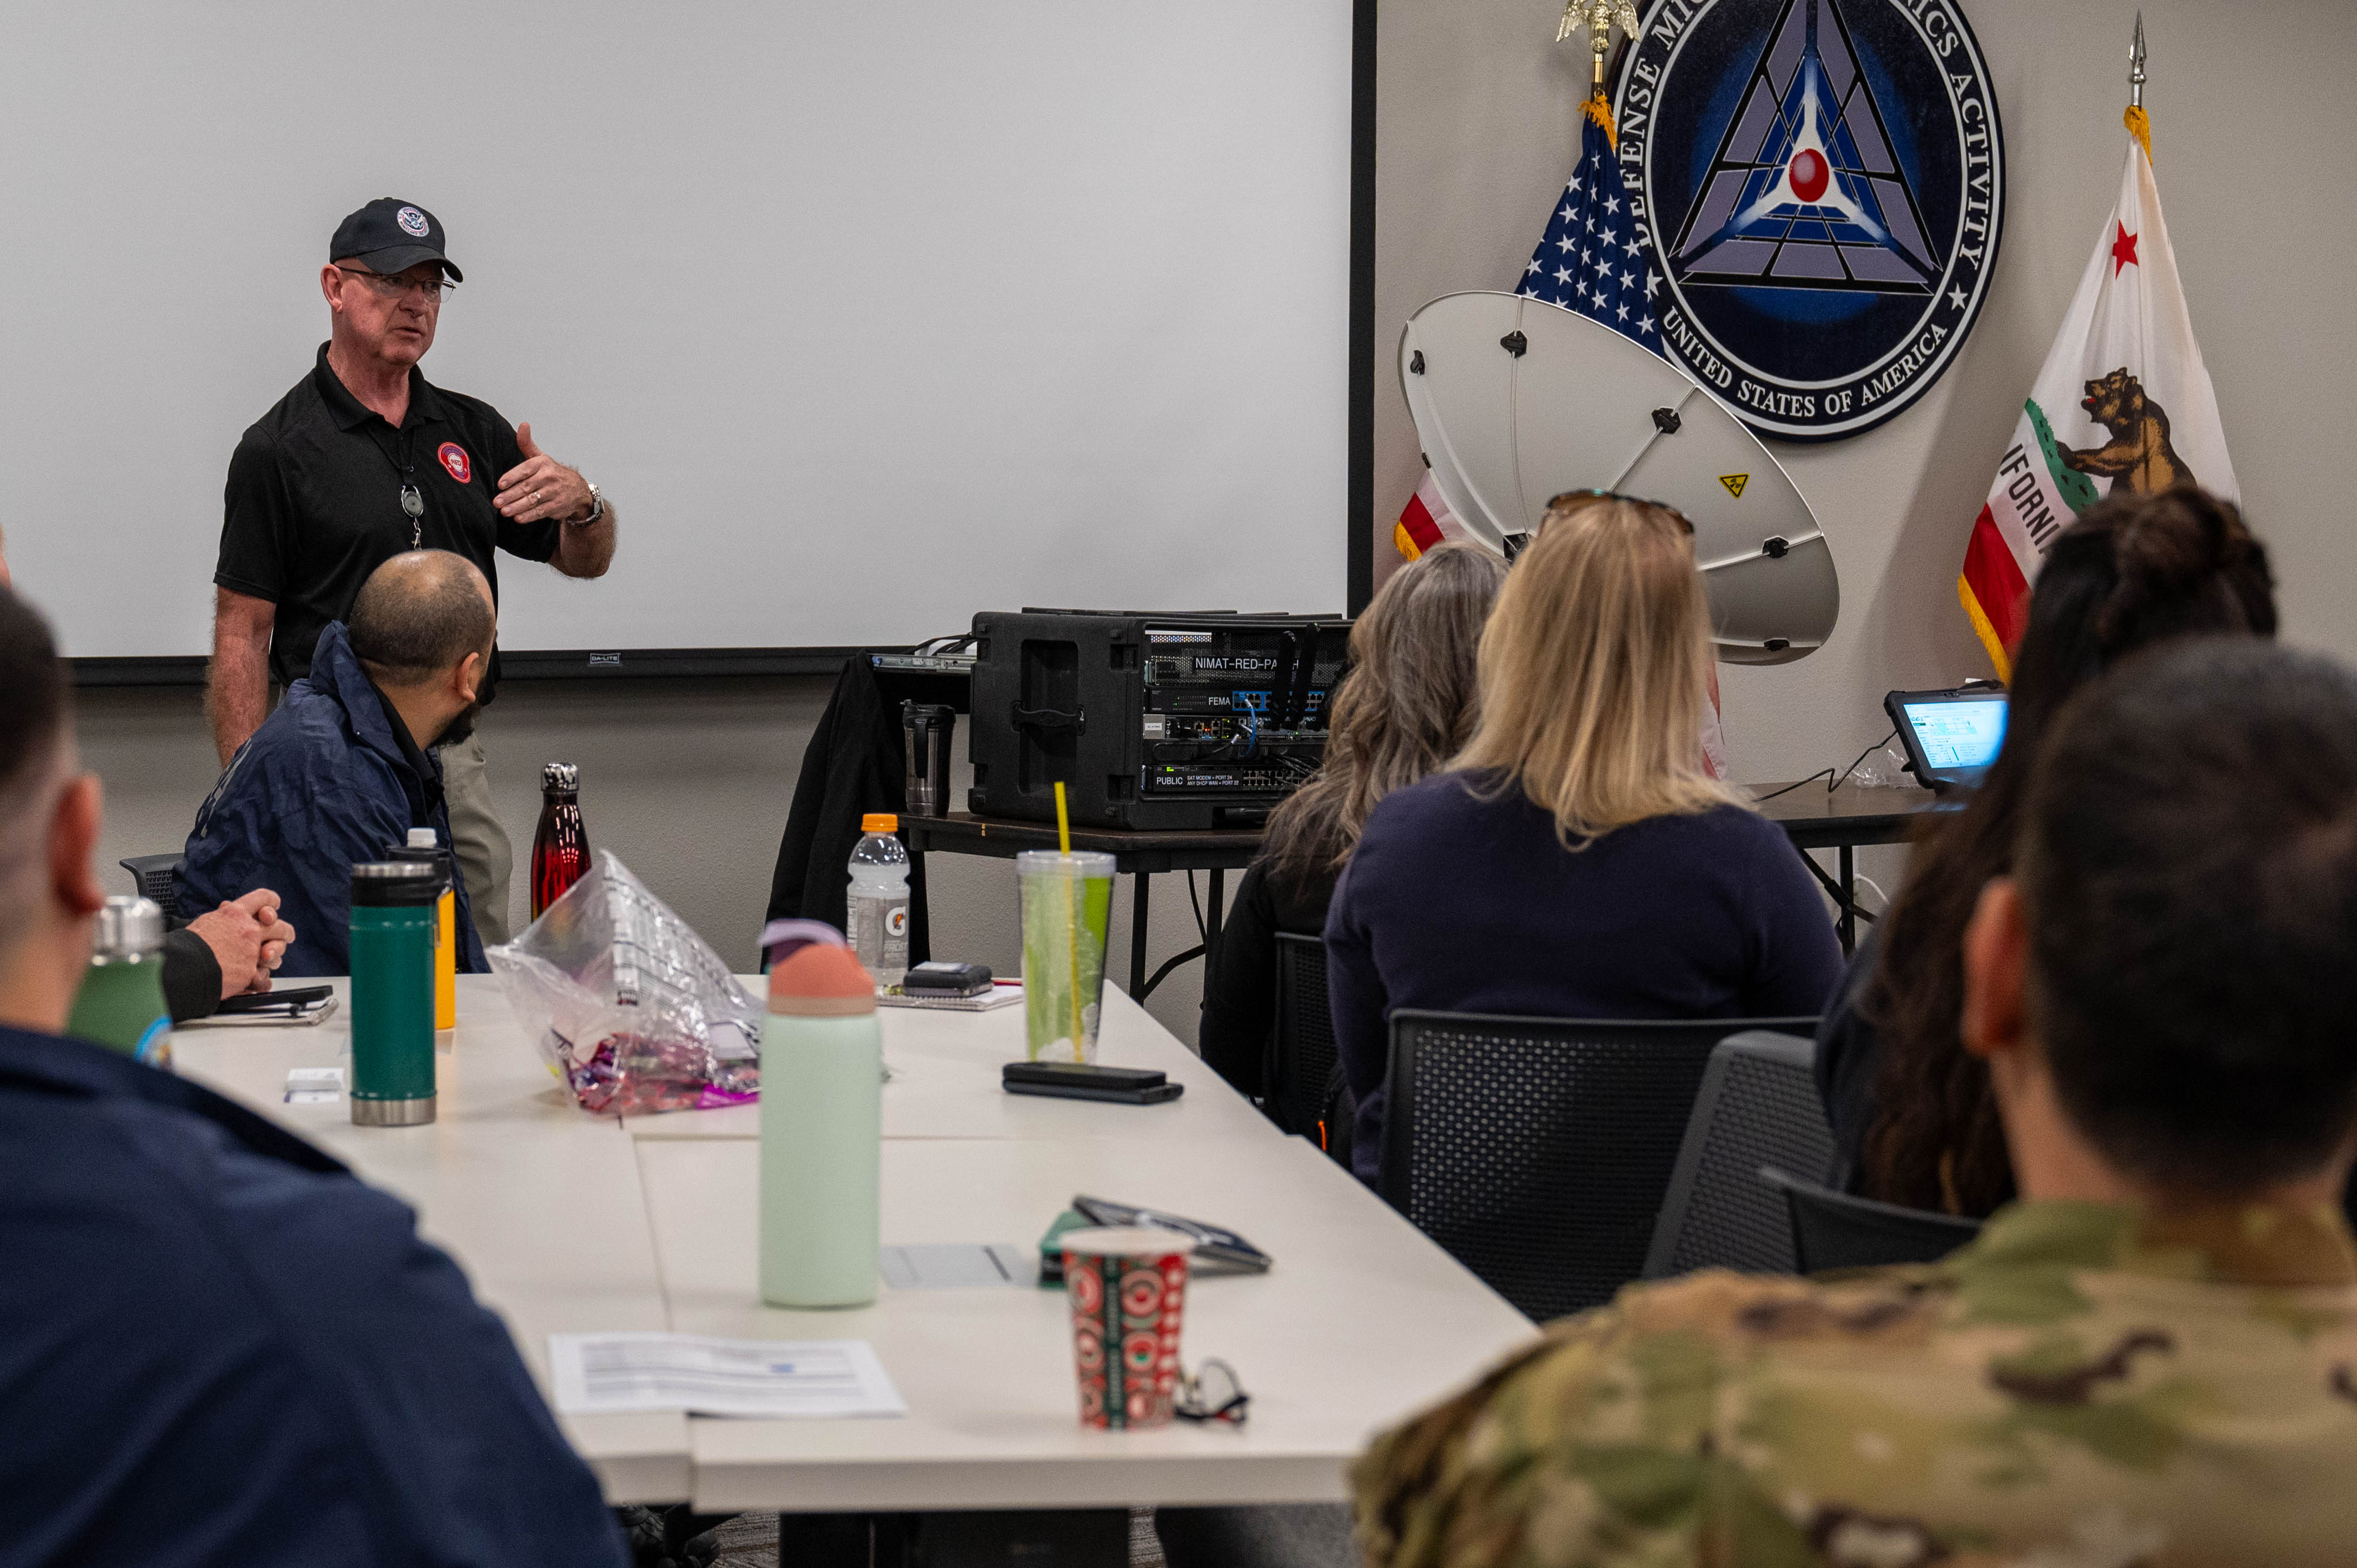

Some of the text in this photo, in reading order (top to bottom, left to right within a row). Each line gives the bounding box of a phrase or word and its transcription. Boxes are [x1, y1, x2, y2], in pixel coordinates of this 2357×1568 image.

[1950, 74, 1990, 270] ACTIVITY
[1664, 306, 1947, 417] UNITED STATES OF AMERICA
[1195, 658, 1299, 669] NIMAT-RED-PAH
[885, 906, 906, 936] G
